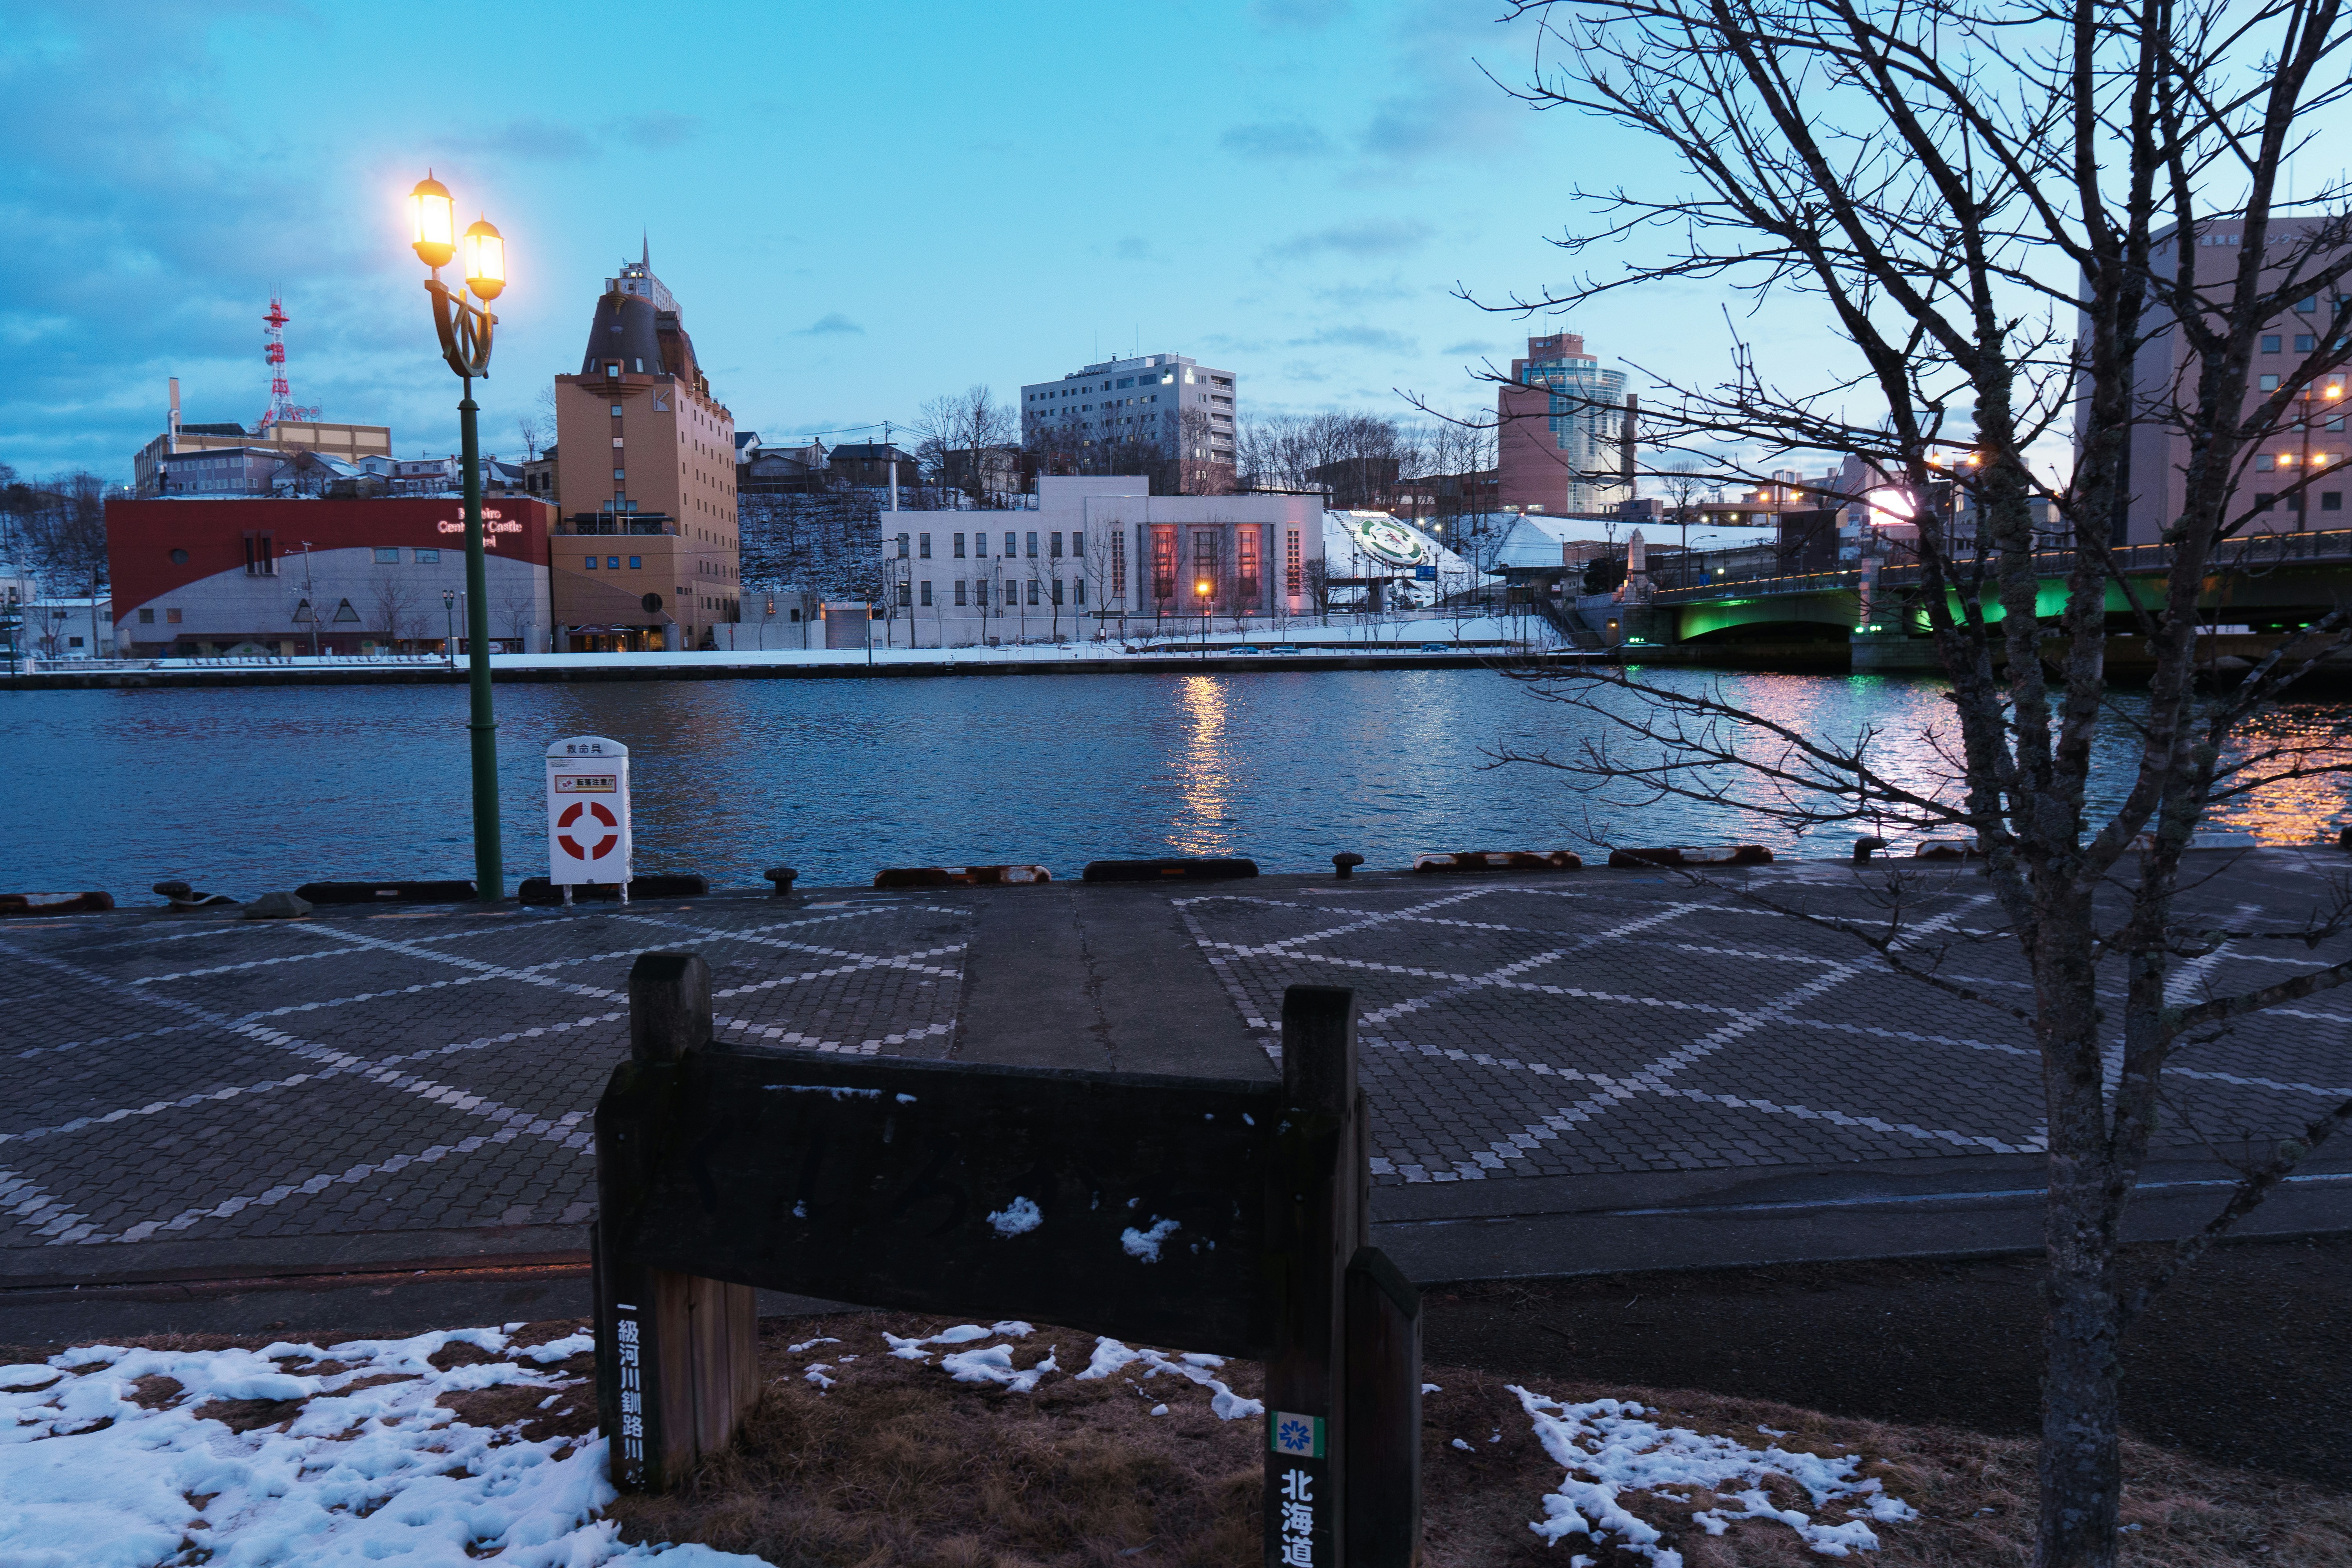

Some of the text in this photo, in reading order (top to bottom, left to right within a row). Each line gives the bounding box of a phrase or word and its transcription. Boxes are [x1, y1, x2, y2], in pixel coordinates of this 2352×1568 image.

[1349, 510, 1389, 518] KUSHIRO
[487, 520, 523, 533] Castle
[566, 744, 602, 754] 救命具
[617, 1304, 644, 1461] 一級河川釧路川
[1281, 1468, 1314, 1568] 北海道
